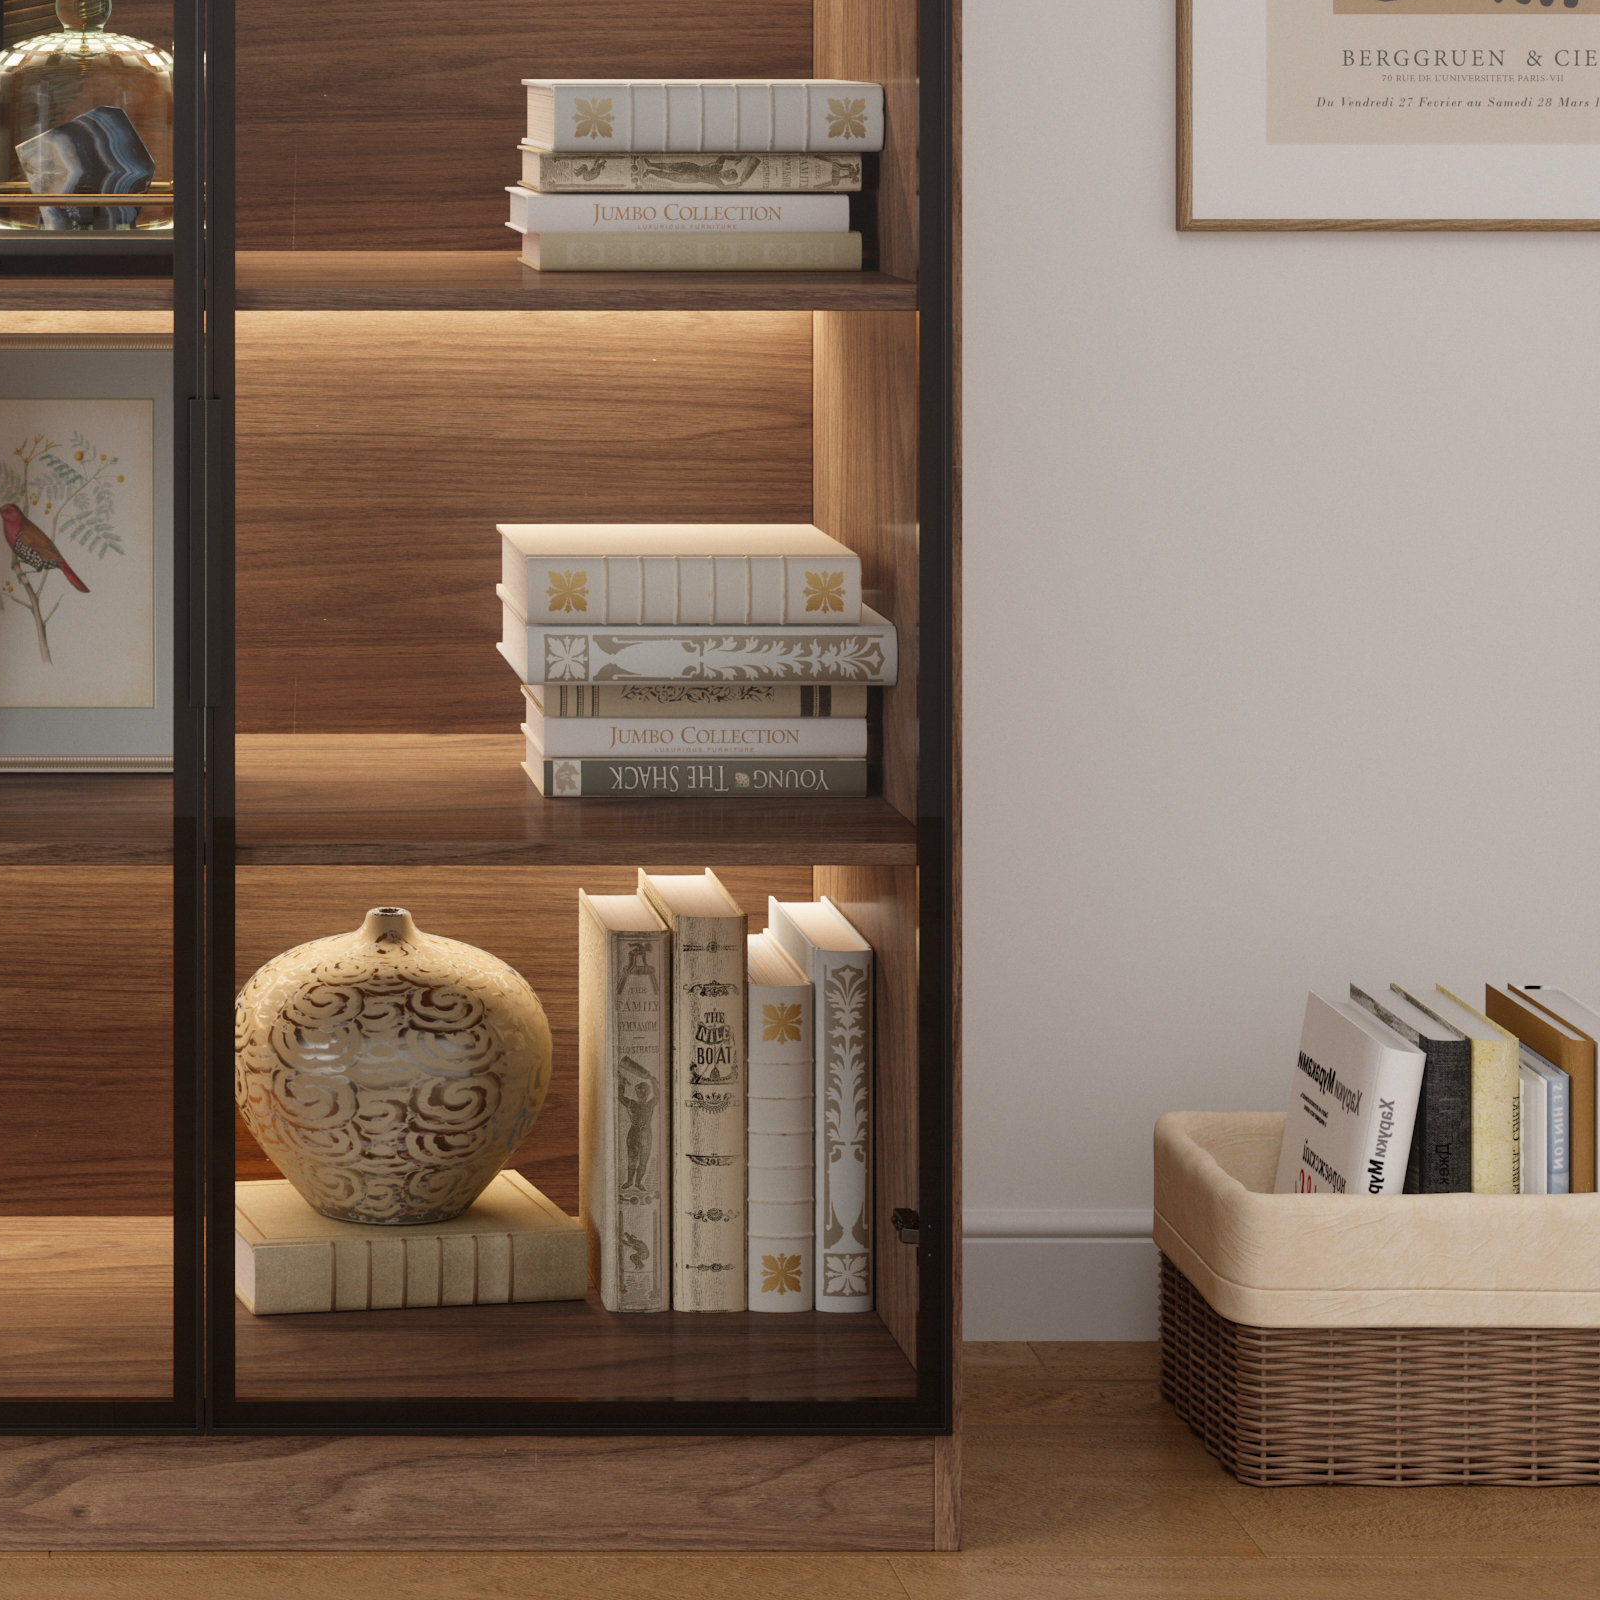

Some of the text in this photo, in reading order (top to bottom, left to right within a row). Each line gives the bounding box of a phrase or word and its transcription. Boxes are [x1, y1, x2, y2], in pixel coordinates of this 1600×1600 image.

[1342, 49, 1598, 67] BERGGRUEN & CIE
[1382, 74, 1393, 82] 70
[1396, 74, 1416, 82] RUE
[1418, 74, 1432, 82] DE
[1518, 74, 1564, 82] PARIS-VII
[1316, 97, 1335, 108] Du
[1341, 96, 1395, 108] Vendredi
[1398, 97, 1414, 108] 27
[1419, 96, 1463, 108] Fevrier
[1466, 99, 1482, 108] au
[1487, 96, 1533, 108] Samedi
[1537, 97, 1553, 108] 28
[1558, 97, 1590, 108] Mars
[608, 765, 830, 792] YOUNG THE SHACK
[704, 1011, 725, 1024] THE
[698, 1047, 732, 1064] BOAT
